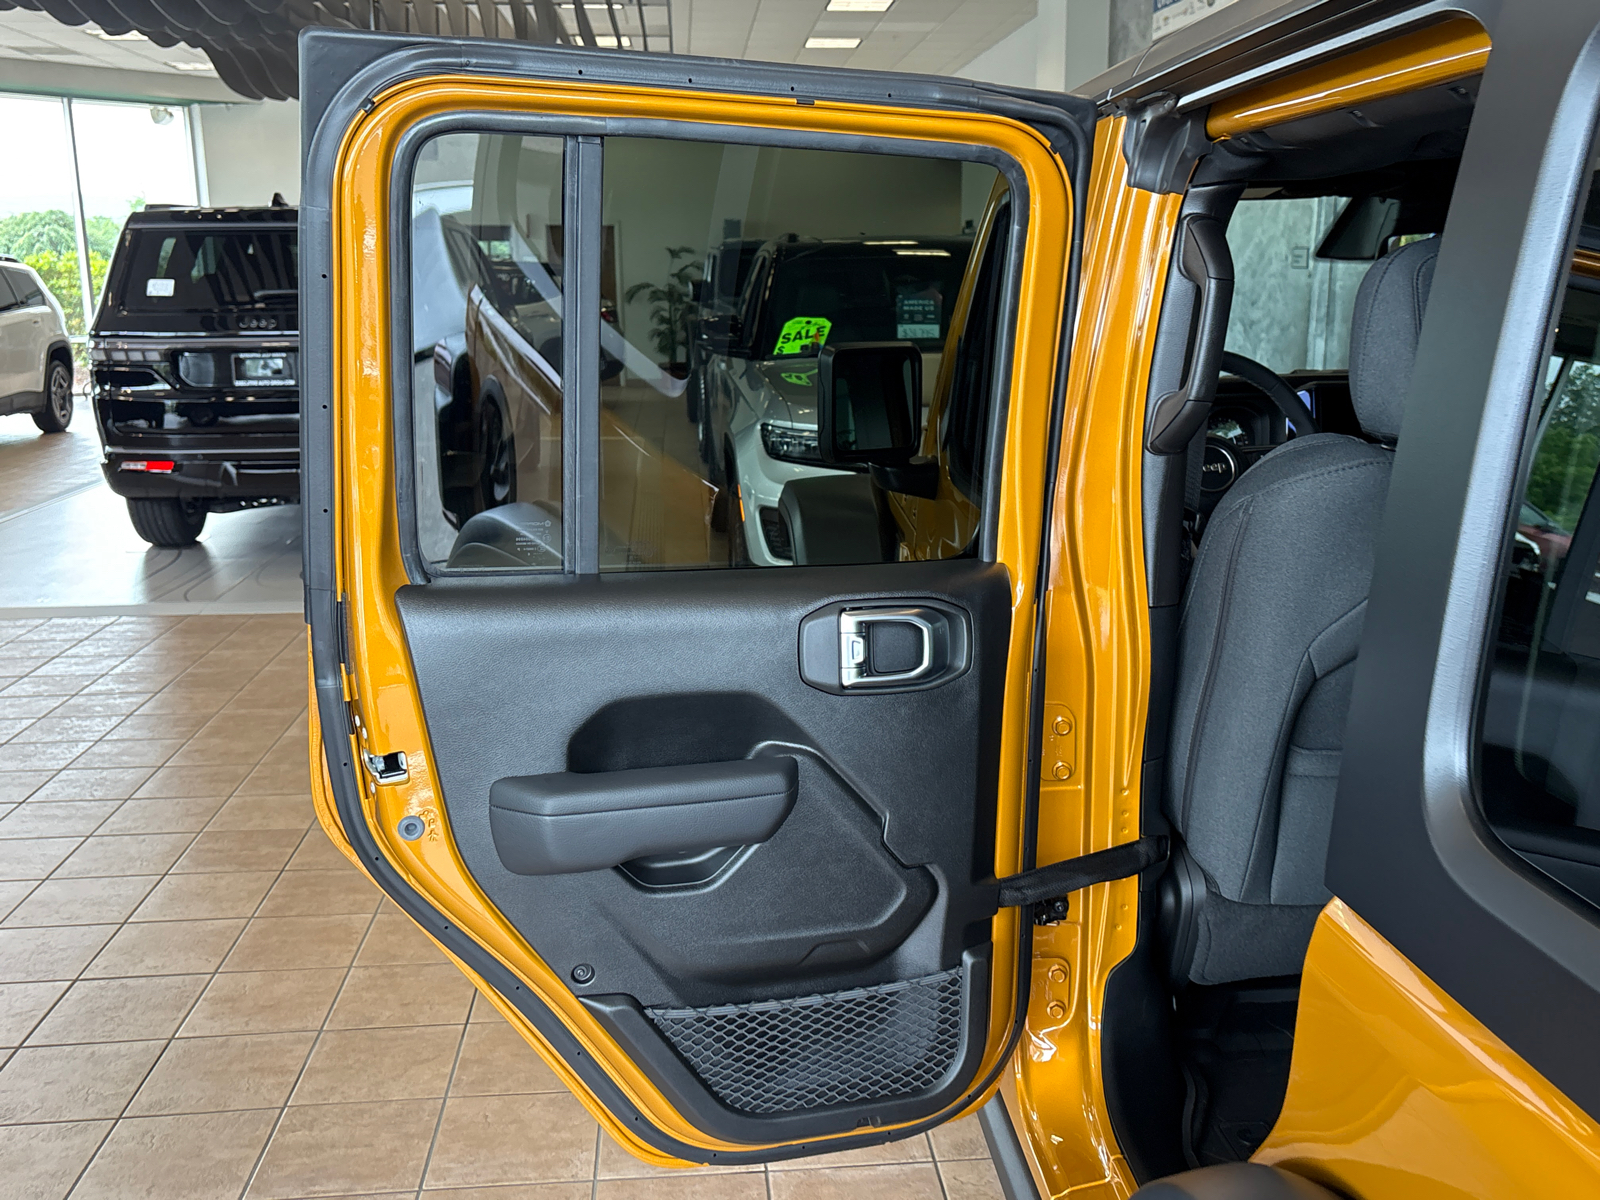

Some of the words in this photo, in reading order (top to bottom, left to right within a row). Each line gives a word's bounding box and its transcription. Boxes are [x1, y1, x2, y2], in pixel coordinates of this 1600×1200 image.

[238, 315, 278, 330] Jeep
[781, 325, 826, 345] SALE
[1202, 462, 1227, 474] eep
